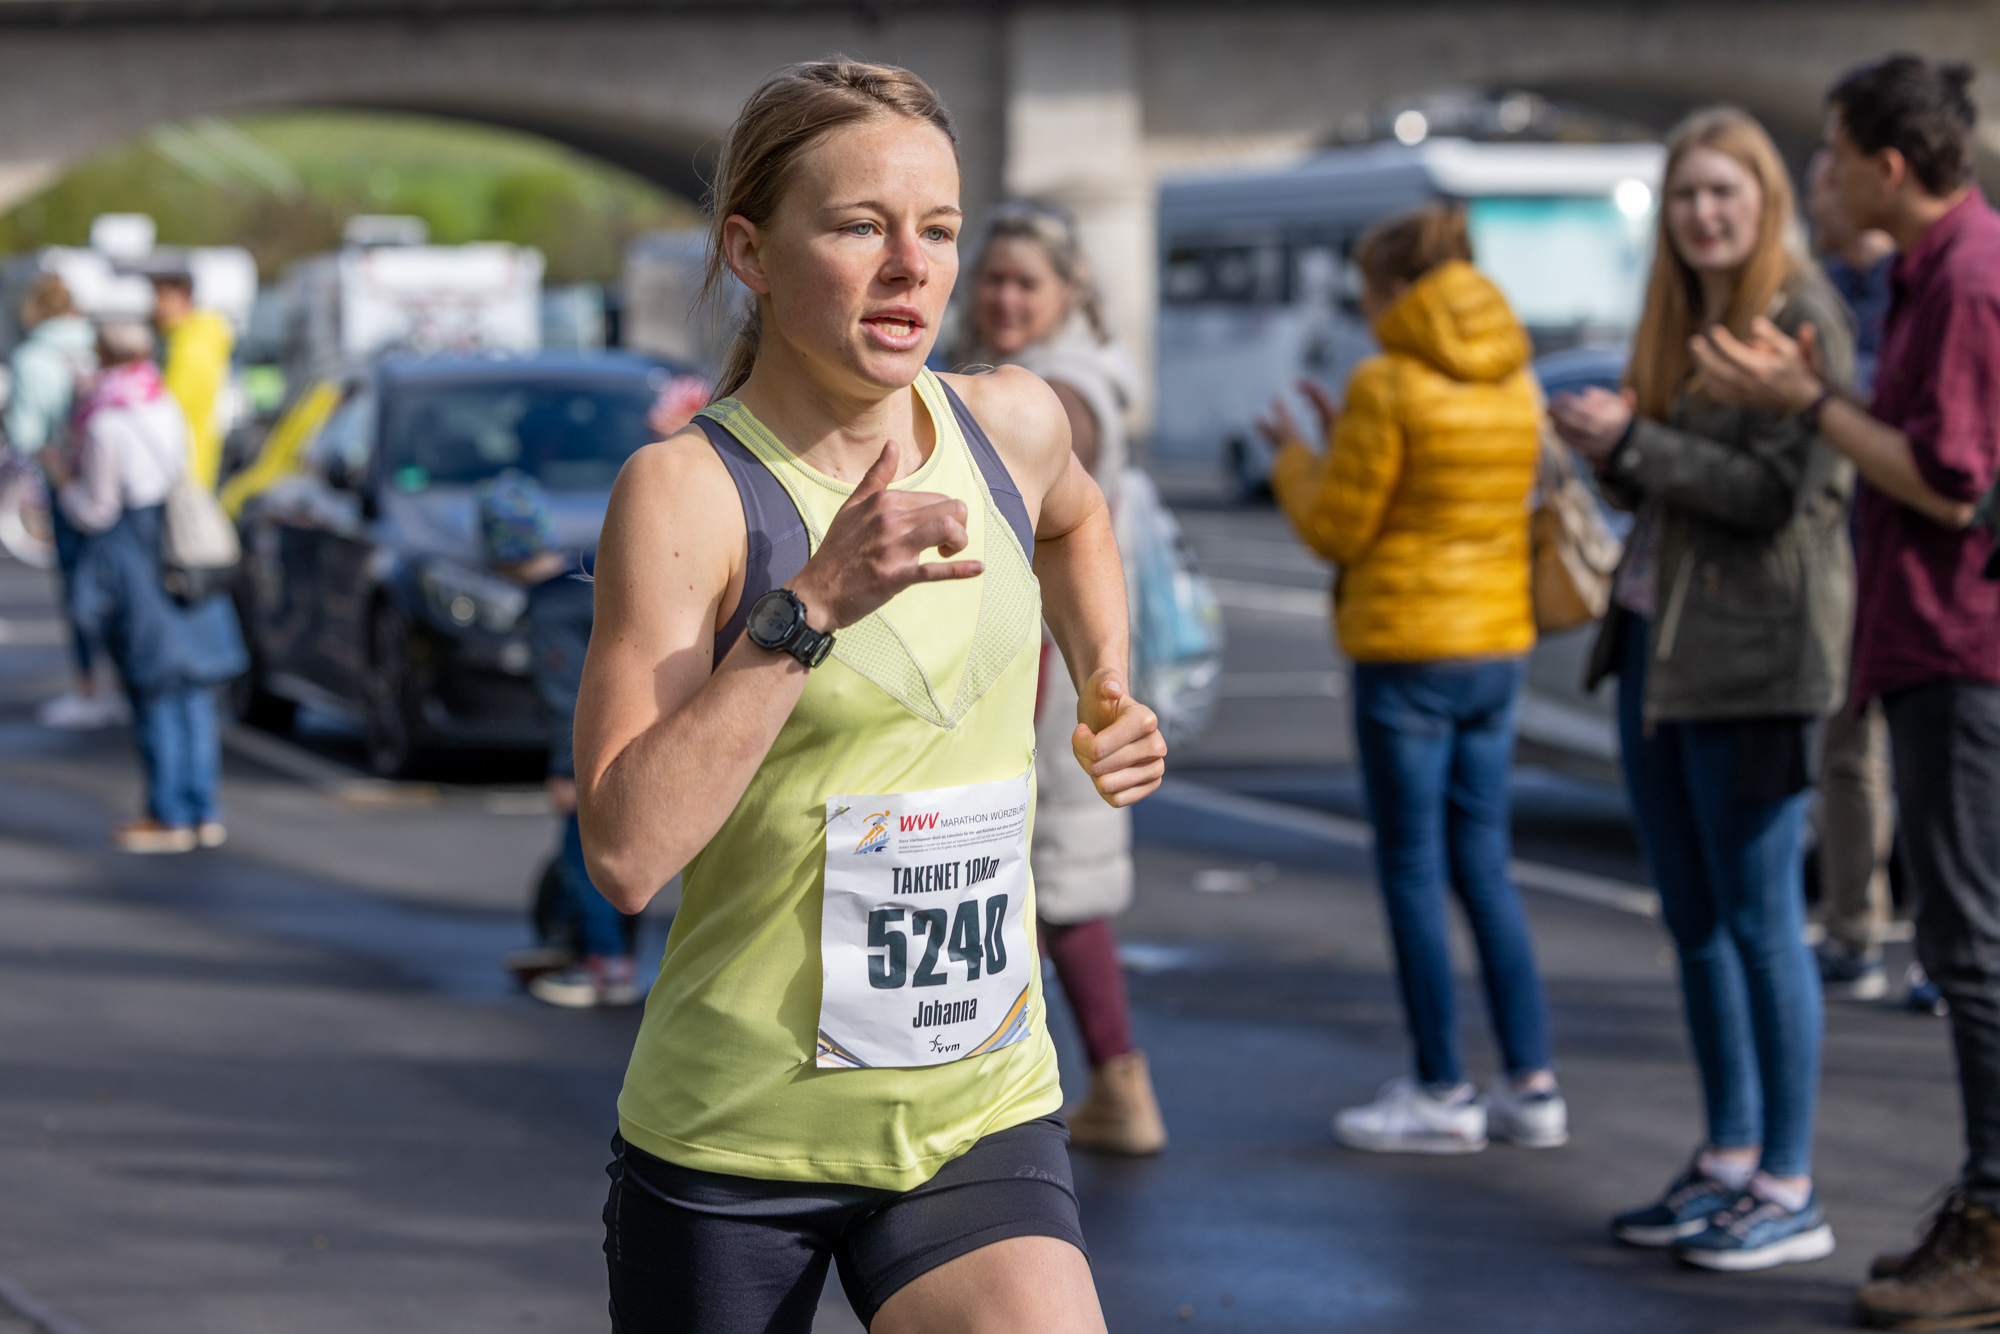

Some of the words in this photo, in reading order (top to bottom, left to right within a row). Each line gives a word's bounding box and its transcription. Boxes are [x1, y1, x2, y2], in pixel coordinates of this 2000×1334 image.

[899, 812, 939, 832] WVV
[940, 813, 988, 828] MARATHON
[990, 802, 1026, 821] WÜRZBURG
[892, 861, 960, 894] TAKENET
[965, 856, 1000, 887] 10Km
[867, 893, 1008, 990] 5240
[912, 997, 978, 1028] Johanna
[937, 1043, 960, 1054] vvm
